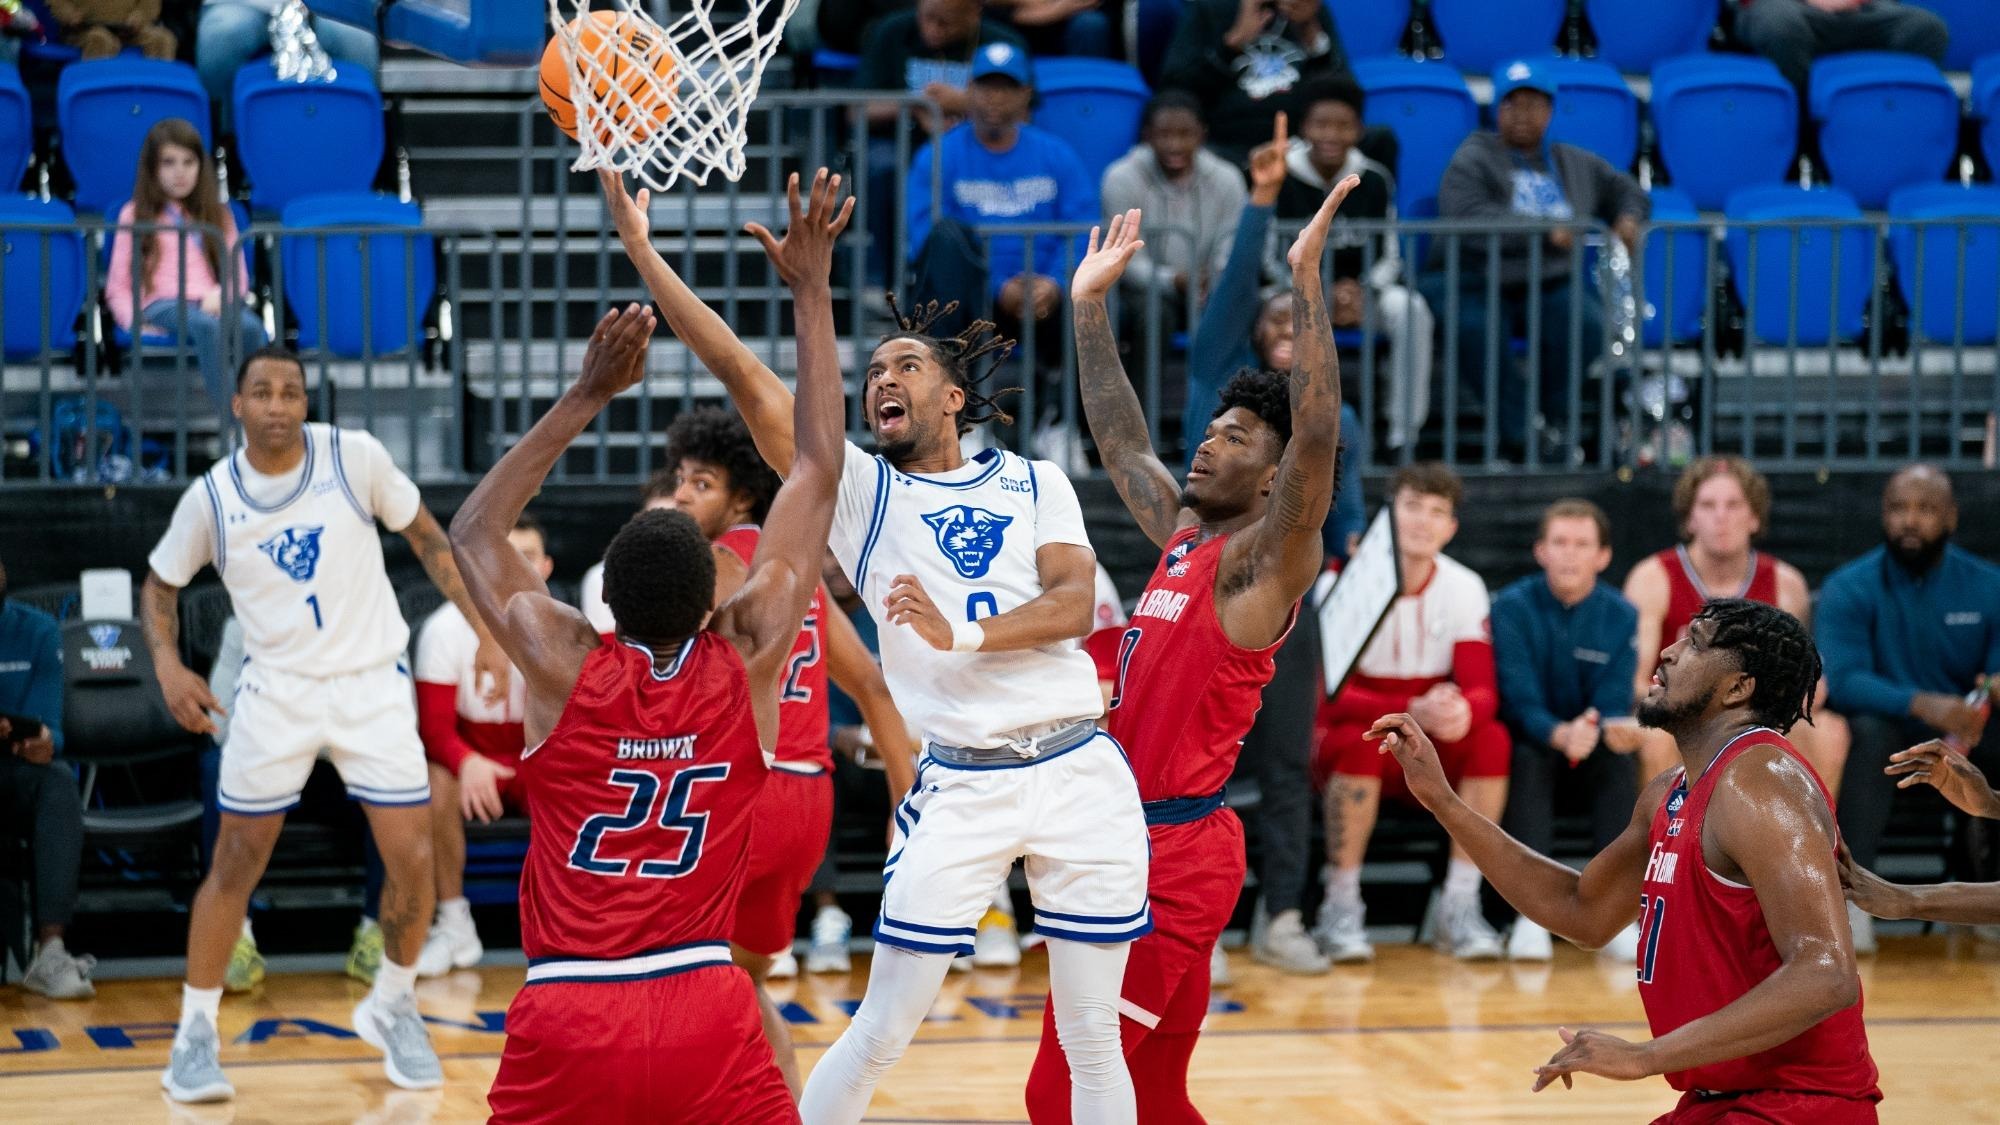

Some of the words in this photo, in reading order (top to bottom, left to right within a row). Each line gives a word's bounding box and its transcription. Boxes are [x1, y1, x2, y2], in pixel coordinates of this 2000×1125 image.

[306, 594, 322, 629] 1
[616, 734, 698, 760] BROWN
[566, 762, 731, 879] 25
